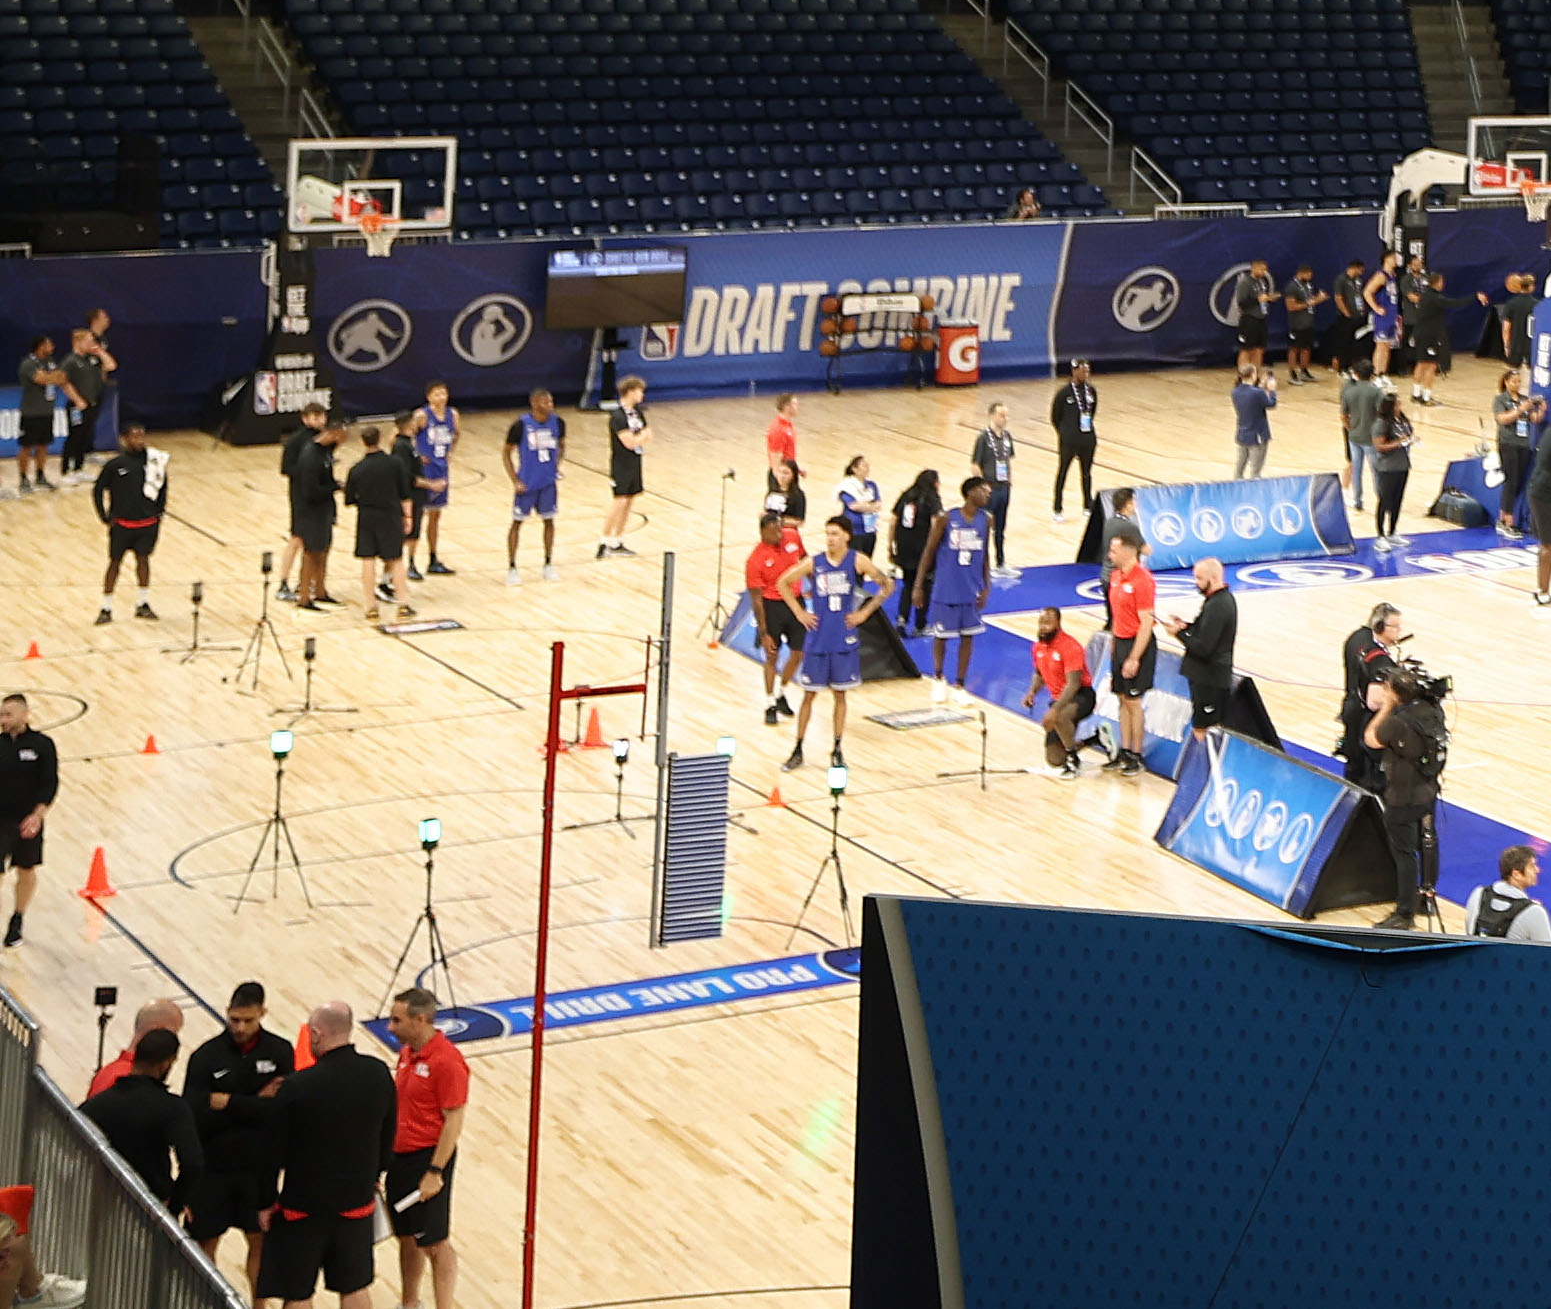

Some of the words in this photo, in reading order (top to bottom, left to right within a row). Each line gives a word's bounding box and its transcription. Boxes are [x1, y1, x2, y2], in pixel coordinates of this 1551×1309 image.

[683, 280, 829, 357] DRAFT
[629, 977, 726, 1006] LANE
[733, 963, 820, 991] PRO
